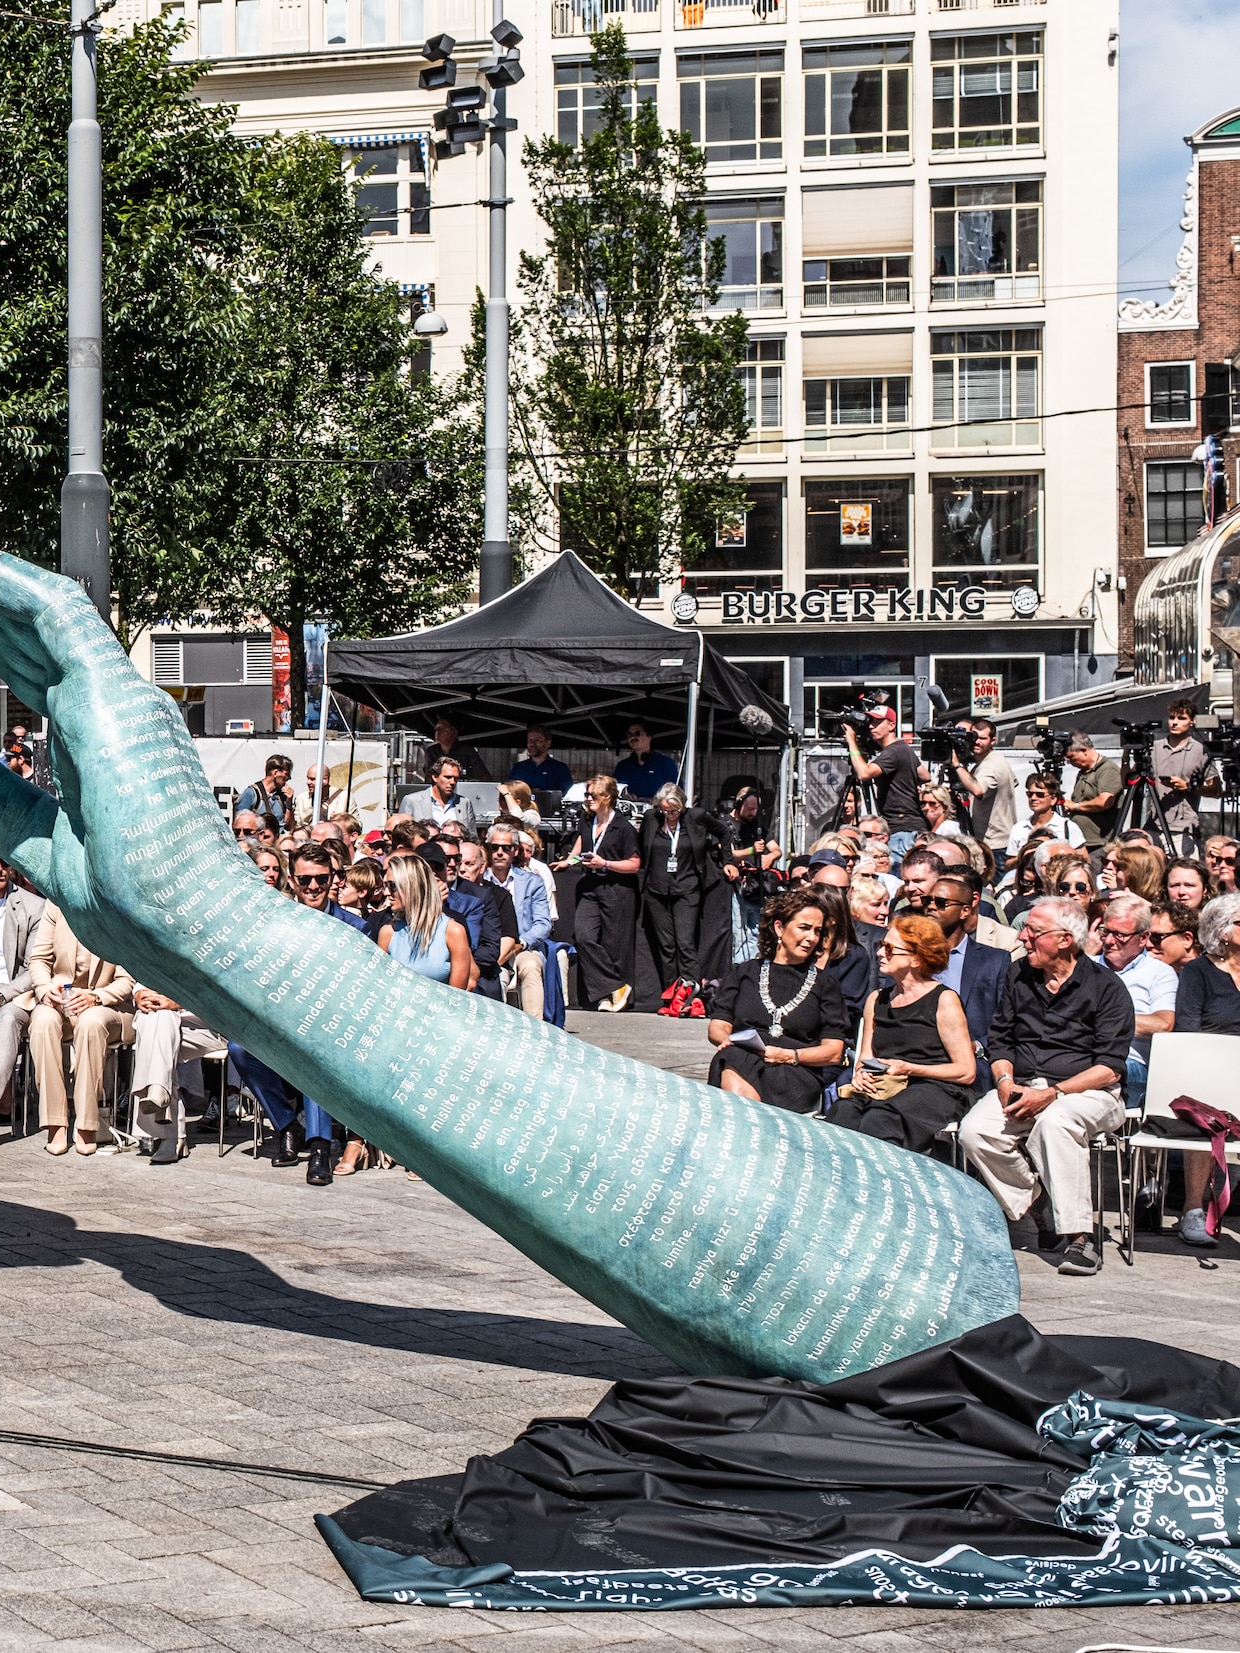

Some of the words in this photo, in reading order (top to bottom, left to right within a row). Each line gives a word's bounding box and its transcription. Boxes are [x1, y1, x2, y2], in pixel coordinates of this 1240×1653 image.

[722, 589, 876, 618] BURGER
[888, 586, 986, 615] KING
[70, 625, 84, 637] co
[918, 676, 928, 689] 7
[974, 678, 999, 688] COOL
[975, 687, 999, 698] DOWN
[116, 781, 133, 796] ka
[177, 889, 207, 918] quem
[189, 922, 204, 935] as
[192, 924, 234, 963] justiça.
[214, 950, 238, 971] Tan
[268, 980, 294, 1004] Dan
[292, 932, 328, 978] alamala
[295, 964, 329, 1004] nedich
[296, 958, 357, 1037] minderheden,
[321, 1013, 343, 1035] fan
[335, 1024, 358, 1049] Dan
[352, 990, 379, 1023] komt
[413, 1103, 428, 1119] je
[422, 1087, 438, 1100] to
[434, 1029, 472, 1087] potrebno,
[431, 1093, 459, 1133] mislite
[459, 1034, 489, 1083] slušajte
[453, 1097, 481, 1135] svojoj
[476, 1067, 497, 1095] deci.
[488, 1032, 510, 1063] Tada
[469, 1117, 494, 1150] wenn
[489, 1079, 516, 1116] nötig
[632, 1091, 644, 1107] το
[496, 1125, 516, 1147] ein,
[509, 1097, 530, 1121] sag
[503, 1090, 555, 1175] Gerechtigkeit.
[548, 1061, 565, 1087] Und
[611, 1180, 636, 1213] τους
[631, 1102, 668, 1177] αδύναμους
[618, 1178, 665, 1248] σκέφτεσαι
[660, 1151, 677, 1175] και
[649, 1227, 665, 1243] το
[660, 1190, 684, 1225] αυτό
[678, 1165, 696, 1189] και
[690, 1131, 709, 1160] στα
[661, 1222, 698, 1270] bimîne...
[692, 1183, 717, 1216] Gava
[712, 1162, 725, 1180] ku
[719, 1119, 736, 1160] pêwîst
[688, 1249, 717, 1290] rastiya
[710, 1219, 733, 1247] hizr
[735, 1154, 758, 1203] ramana
[717, 1268, 740, 1300] yekê
[735, 1192, 776, 1267] veguhezîne
[769, 1138, 789, 1189] zarokên
[878, 1196, 894, 1228] tsoro
[926, 1206, 939, 1229] and
[949, 1212, 966, 1238] pass
[871, 1231, 886, 1249] da
[924, 1232, 939, 1267] weak
[951, 1239, 964, 1267] And
[781, 1306, 817, 1347] lokacin
[813, 1288, 828, 1305] da
[825, 1260, 843, 1286] ake
[836, 1210, 867, 1258] bukata,
[855, 1189, 869, 1205] ka
[855, 1252, 876, 1280] tare
[834, 1357, 852, 1374] wa
[848, 1305, 884, 1356] yaranka.
[877, 1239, 912, 1300] Sa'annan
[903, 1202, 916, 1237] komai
[843, 1284, 861, 1302] ba
[912, 1271, 929, 1295] the
[934, 1269, 960, 1319] justice.
[899, 1298, 918, 1320] for
[807, 1304, 850, 1362] tunaninku
[890, 1324, 907, 1341] up
[926, 1318, 940, 1337] of
